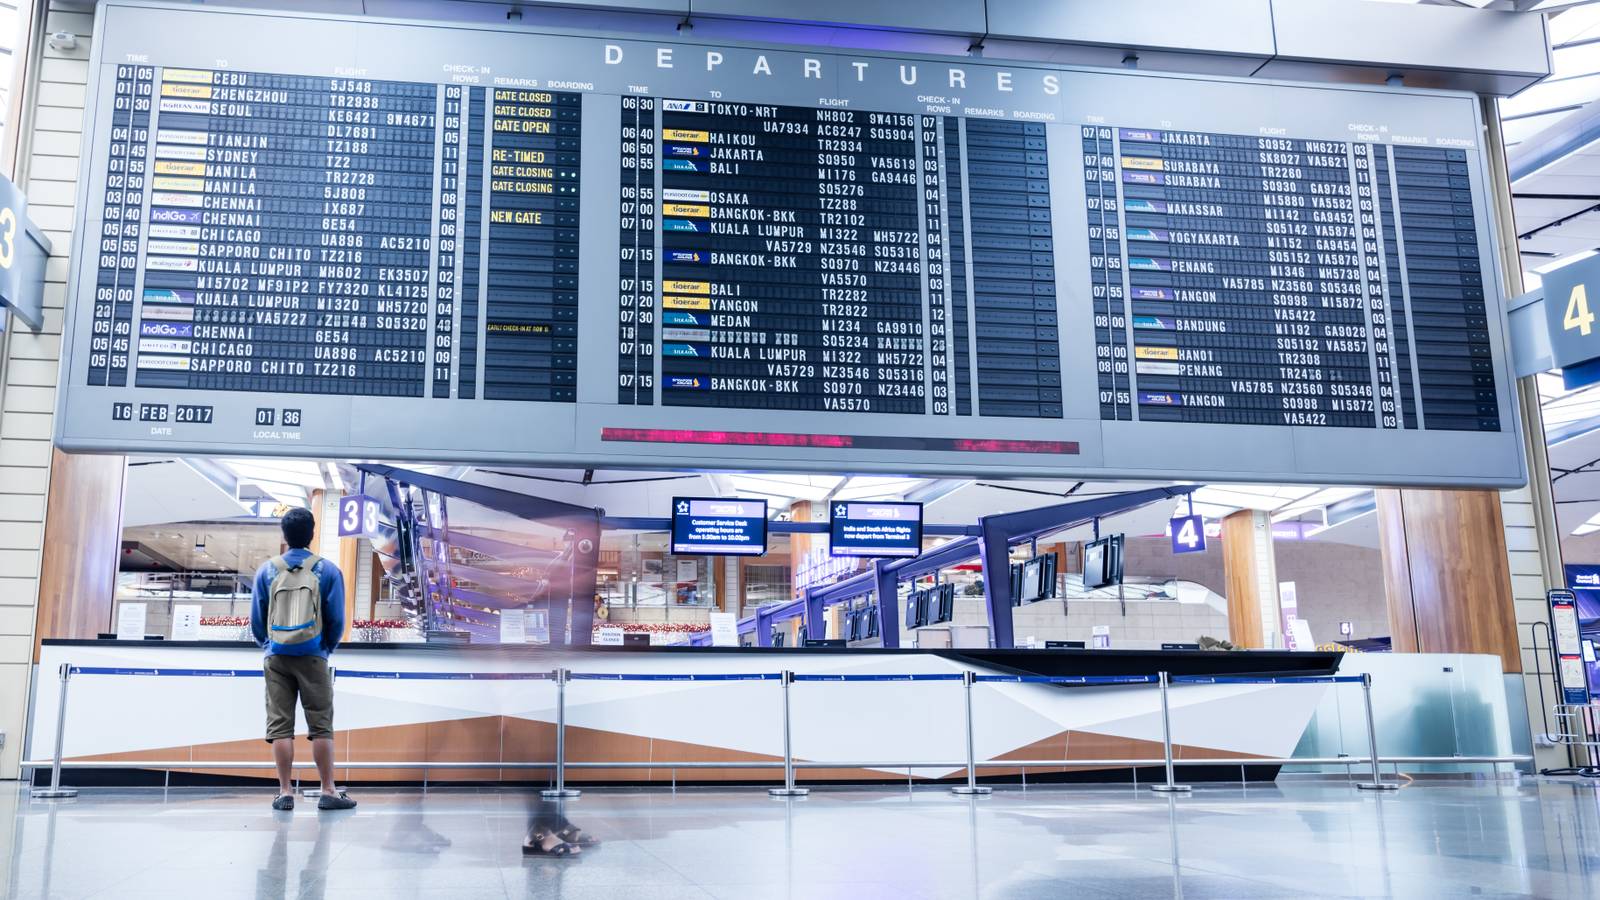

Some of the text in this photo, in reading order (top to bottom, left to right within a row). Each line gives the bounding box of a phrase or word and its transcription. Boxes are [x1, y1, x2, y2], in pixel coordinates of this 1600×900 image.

[127, 54, 148, 62] TIME
[214, 73, 246, 85] CEBU
[452, 75, 479, 83] ROWS
[494, 78, 538, 87] REMARKS
[331, 80, 371, 93] 5J548
[548, 81, 593, 90] BOARDING
[211, 88, 287, 103] ZHENGZHOU
[496, 91, 551, 103] GATE CLOSED
[819, 98, 849, 107] FLIGHT
[211, 103, 251, 116] SEOUL
[710, 104, 778, 118] TOKYO-NRT
[927, 105, 951, 113] ROWS
[964, 108, 1003, 117] REMARKS
[1013, 110, 1054, 120] BOARDING
[329, 110, 369, 123] KE642
[387, 114, 434, 126] 9W4671
[817, 111, 853, 122] NH802
[495, 120, 549, 132] GATE OPEN
[210, 134, 268, 148] TIANJIN
[710, 133, 755, 145] HAIKOU
[1163, 133, 1210, 145] JAKARTA
[208, 150, 258, 163] SYDNEY
[710, 148, 763, 160] JAKARTA
[819, 154, 855, 166] SQ950
[327, 156, 350, 167] TZ2
[1164, 161, 1219, 173] SURABAYA
[205, 166, 257, 179] MANILA
[492, 166, 552, 177] GATE CLOSING
[710, 162, 738, 174] BALI
[493, 181, 552, 193] GATE CLOSING
[1165, 175, 1220, 188] SURABAYA
[204, 182, 255, 194] MANILA
[325, 187, 365, 199] 5J808
[203, 196, 261, 210] CHENNAI
[711, 193, 748, 204] OSAKA
[820, 198, 856, 210] TZ288
[325, 203, 364, 215] IX687
[711, 208, 795, 221] BANGKOK-BKK
[1168, 204, 1223, 216] MAKASSAR
[153, 210, 186, 221] IndiGo
[203, 213, 260, 226] CHENNAI
[492, 211, 541, 223] NEW GATE
[202, 229, 260, 242] CHICAGO
[711, 222, 803, 237] KUALA LUMPUR
[820, 228, 857, 240] MI322
[322, 234, 363, 247] UA896
[381, 237, 429, 249] AC5210
[874, 231, 918, 243] MH5722
[1170, 232, 1239, 245] YOGYAKARTA
[200, 244, 259, 258] SAPPORO
[766, 240, 811, 253] VA5729
[821, 243, 865, 256] NZ3546
[875, 246, 919, 258] SQ5316
[321, 250, 362, 262] TZ216
[711, 253, 796, 267] BANGKOK-BKK
[198, 260, 240, 273] KUALA
[251, 263, 301, 276] LUMPUR
[821, 258, 858, 270] SQ970
[875, 261, 919, 273] NZ3446
[1172, 261, 1213, 273] PENANG
[320, 266, 360, 279] MH602
[380, 269, 429, 283] EK3507
[198, 277, 248, 290] MI5702
[822, 274, 866, 286] VA5570
[319, 282, 368, 295] FY7320
[712, 284, 740, 295] BALI
[196, 293, 299, 308] KUALA LUMPUR
[822, 289, 866, 301] TR2282
[1174, 290, 1216, 302] YANGON
[712, 300, 758, 312] YANGON
[1563, 283, 1595, 337] 4
[712, 315, 750, 327] MEDAN
[1177, 320, 1225, 332] BANDUNG
[143, 324, 176, 334] IndiGo
[194, 326, 251, 339] CHENNAI
[877, 322, 922, 334] GA9910
[191, 342, 252, 355] CHICAGO
[712, 346, 806, 361] KUALA LUMPUR
[1179, 364, 1222, 376] PENANG
[712, 378, 798, 392] BANGKOK-BKK
[1182, 395, 1224, 406] YANGON
[151, 427, 172, 436] DATE
[282, 432, 301, 440] TIME
[343, 500, 359, 532] 3
[366, 502, 376, 533] 3
[1177, 520, 1199, 548] 4
